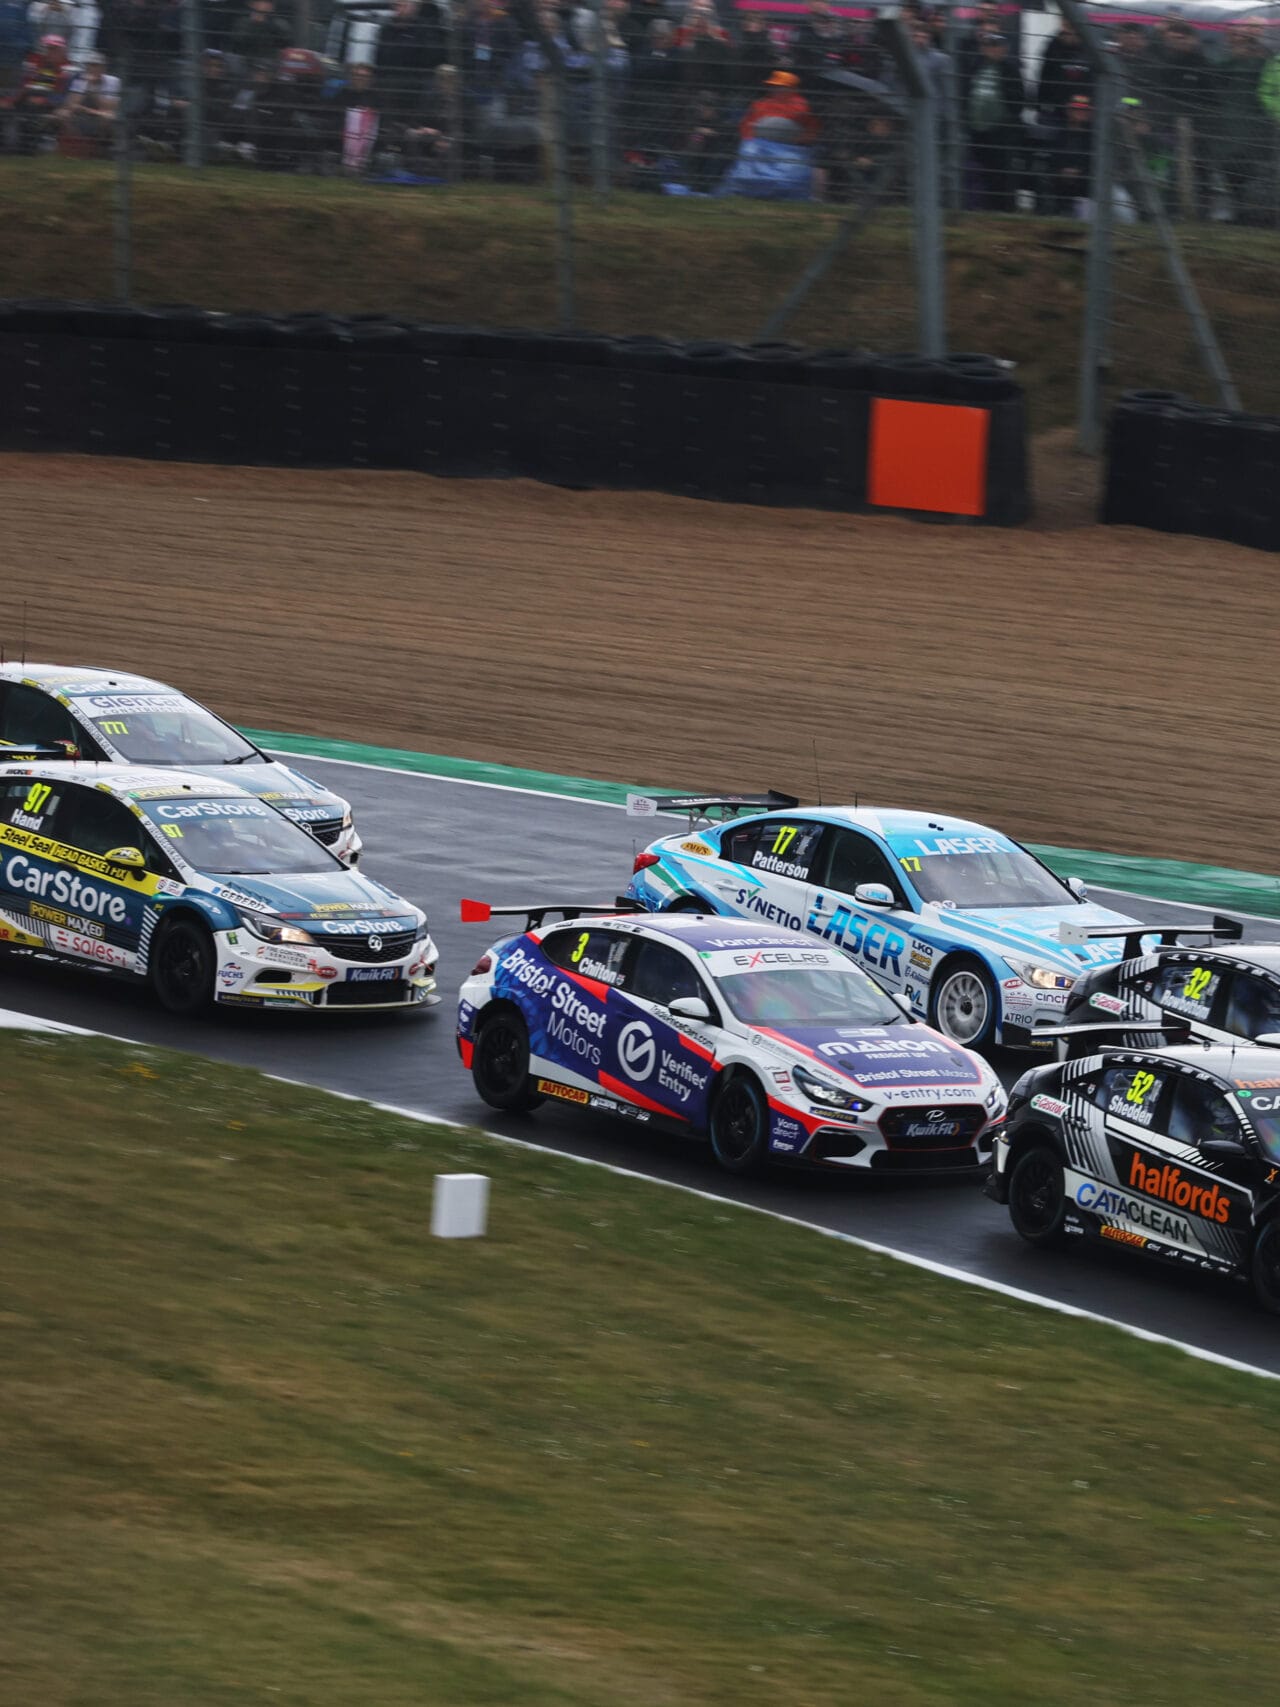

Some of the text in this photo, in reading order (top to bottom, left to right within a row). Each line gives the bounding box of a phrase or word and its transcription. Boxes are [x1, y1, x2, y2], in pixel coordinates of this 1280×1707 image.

[99, 721, 129, 735] 777
[24, 783, 52, 813] 97
[156, 802, 267, 819] CarStore
[11, 808, 44, 831] Hand
[284, 808, 330, 821] Store
[1, 828, 29, 847] Steel
[31, 836, 53, 857] Seal
[160, 824, 184, 838] 97
[771, 825, 797, 855] 17
[913, 837, 1011, 856] LASER
[752, 850, 809, 880] Patterson
[900, 856, 923, 873] 17
[6, 855, 127, 922] CarStore
[220, 889, 267, 912] GEBERIT
[31, 903, 104, 939] POWER MAXED
[321, 919, 403, 935] CarStore
[807, 893, 905, 977] LASER
[73, 936, 128, 968] sales-i
[571, 932, 590, 963] 3
[912, 940, 934, 958] LKQ
[1059, 942, 1123, 966] LAS
[217, 970, 245, 980] FUCHS
[500, 947, 553, 998] Bristol
[578, 956, 618, 986] Chilton
[1183, 967, 1212, 1000] 32
[550, 981, 608, 1039] Street
[547, 1010, 602, 1066] Motors
[661, 1049, 708, 1090] Verified
[854, 1070, 899, 1083] Bristol
[900, 1069, 939, 1079] Street
[541, 1081, 588, 1104] AUTOCAR
[658, 1068, 692, 1102] Entry
[884, 1087, 977, 1100] v-entry.com
[1125, 1070, 1155, 1105] 52
[777, 1118, 799, 1131] Vans
[1108, 1095, 1154, 1126] Shedden
[772, 1127, 798, 1139] direct
[1130, 1152, 1231, 1224] halfords
[1076, 1183, 1189, 1244] CATACLEAN
[1103, 1227, 1145, 1246] AUTOCAR
